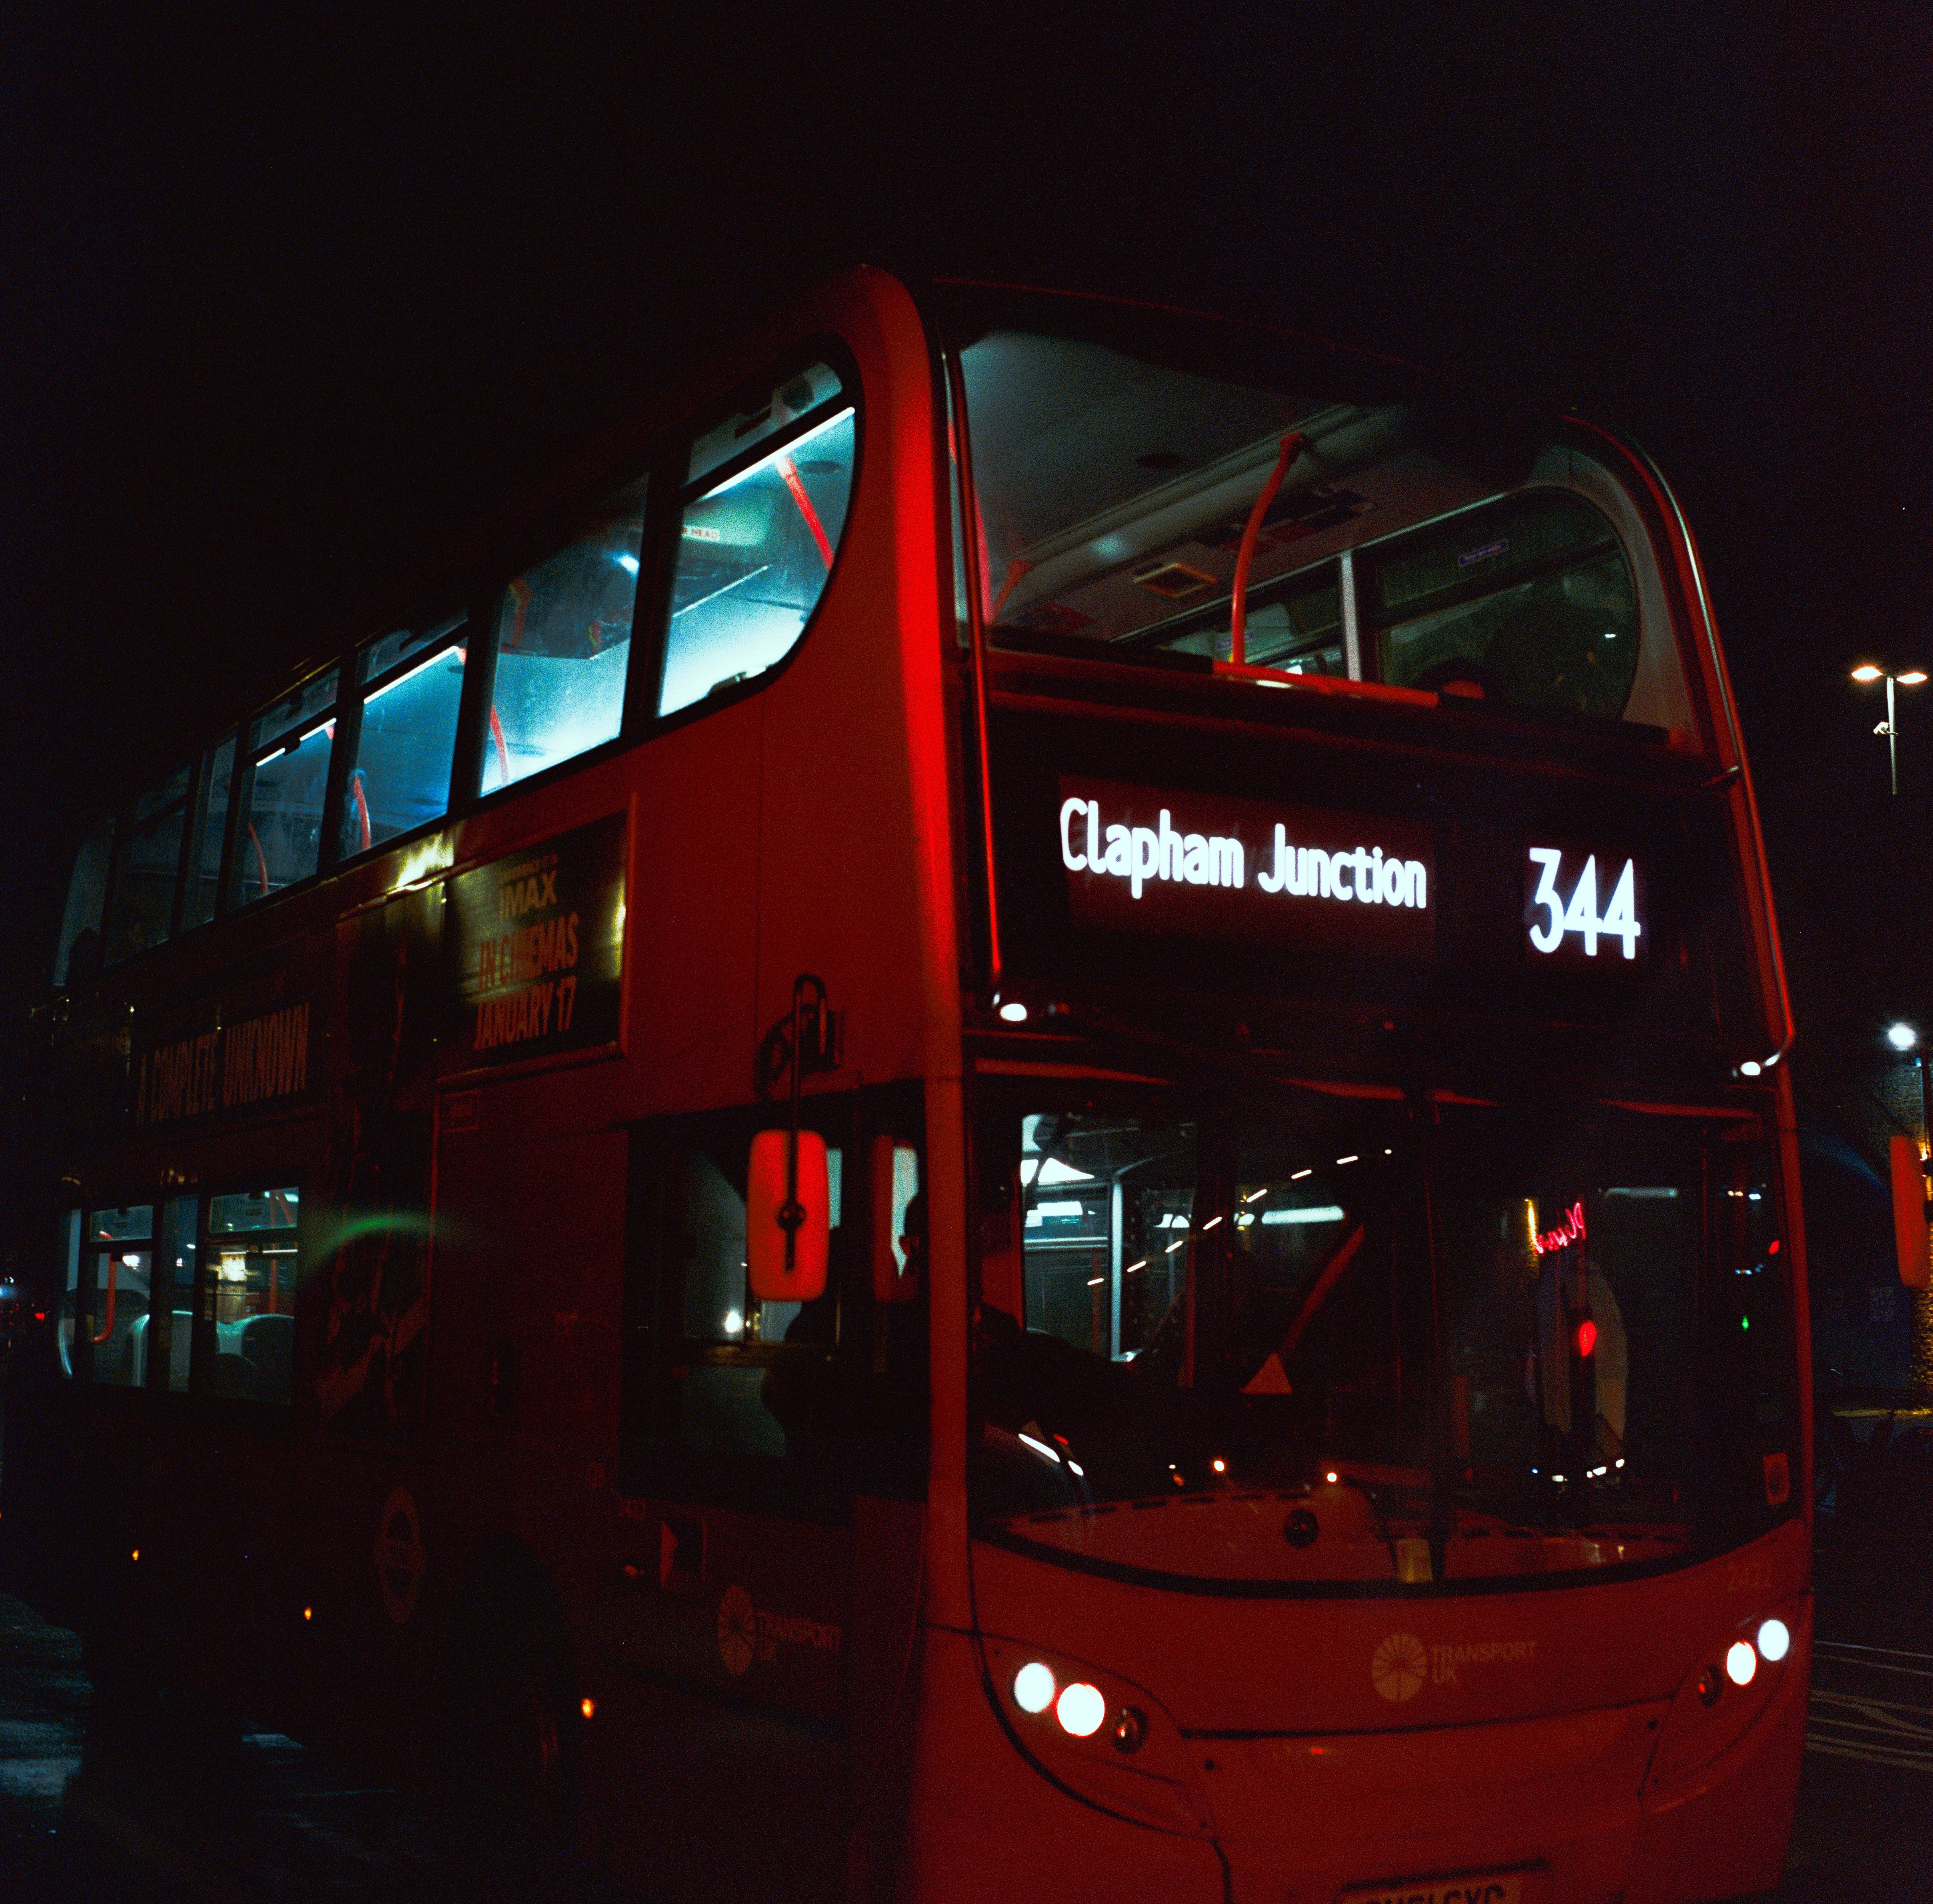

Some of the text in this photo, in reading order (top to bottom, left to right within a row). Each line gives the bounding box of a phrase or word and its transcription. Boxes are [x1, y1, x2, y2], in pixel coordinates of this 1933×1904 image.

[1060, 798, 1427, 908] Clapham Junction
[498, 869, 558, 920] IMAX
[1529, 848, 1641, 959] 344
[500, 912, 579, 985] CINEMAS
[474, 975, 578, 1051] JANUARY 17
[223, 1002, 310, 1108] UNKNOWN
[757, 1610, 842, 1652] TRANSPORT
[1430, 1640, 1538, 1662] TRANSPORT
[1432, 1665, 1458, 1684] UK
